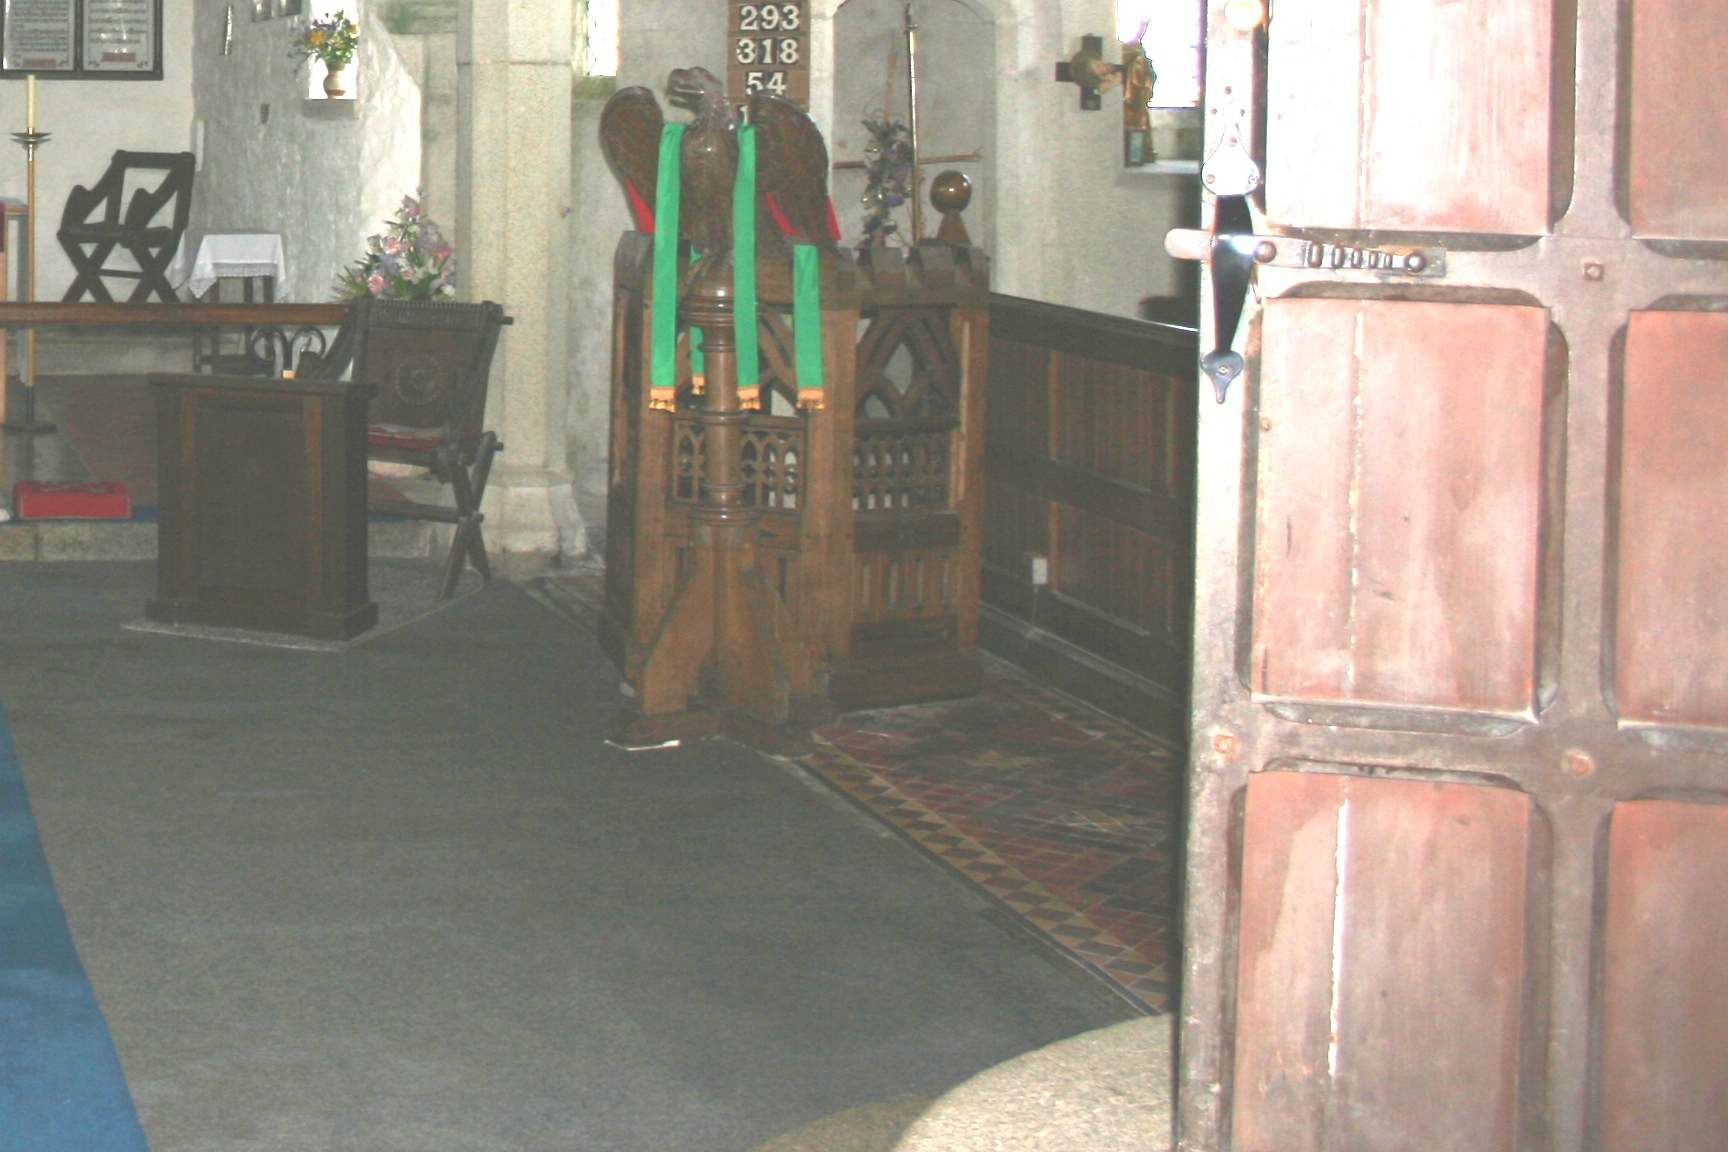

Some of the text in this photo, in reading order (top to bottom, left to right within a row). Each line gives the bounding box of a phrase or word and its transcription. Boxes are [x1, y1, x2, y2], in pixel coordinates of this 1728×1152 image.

[740, 4, 800, 30] 293
[736, 38, 800, 64] 318
[746, 72, 787, 95] 54
